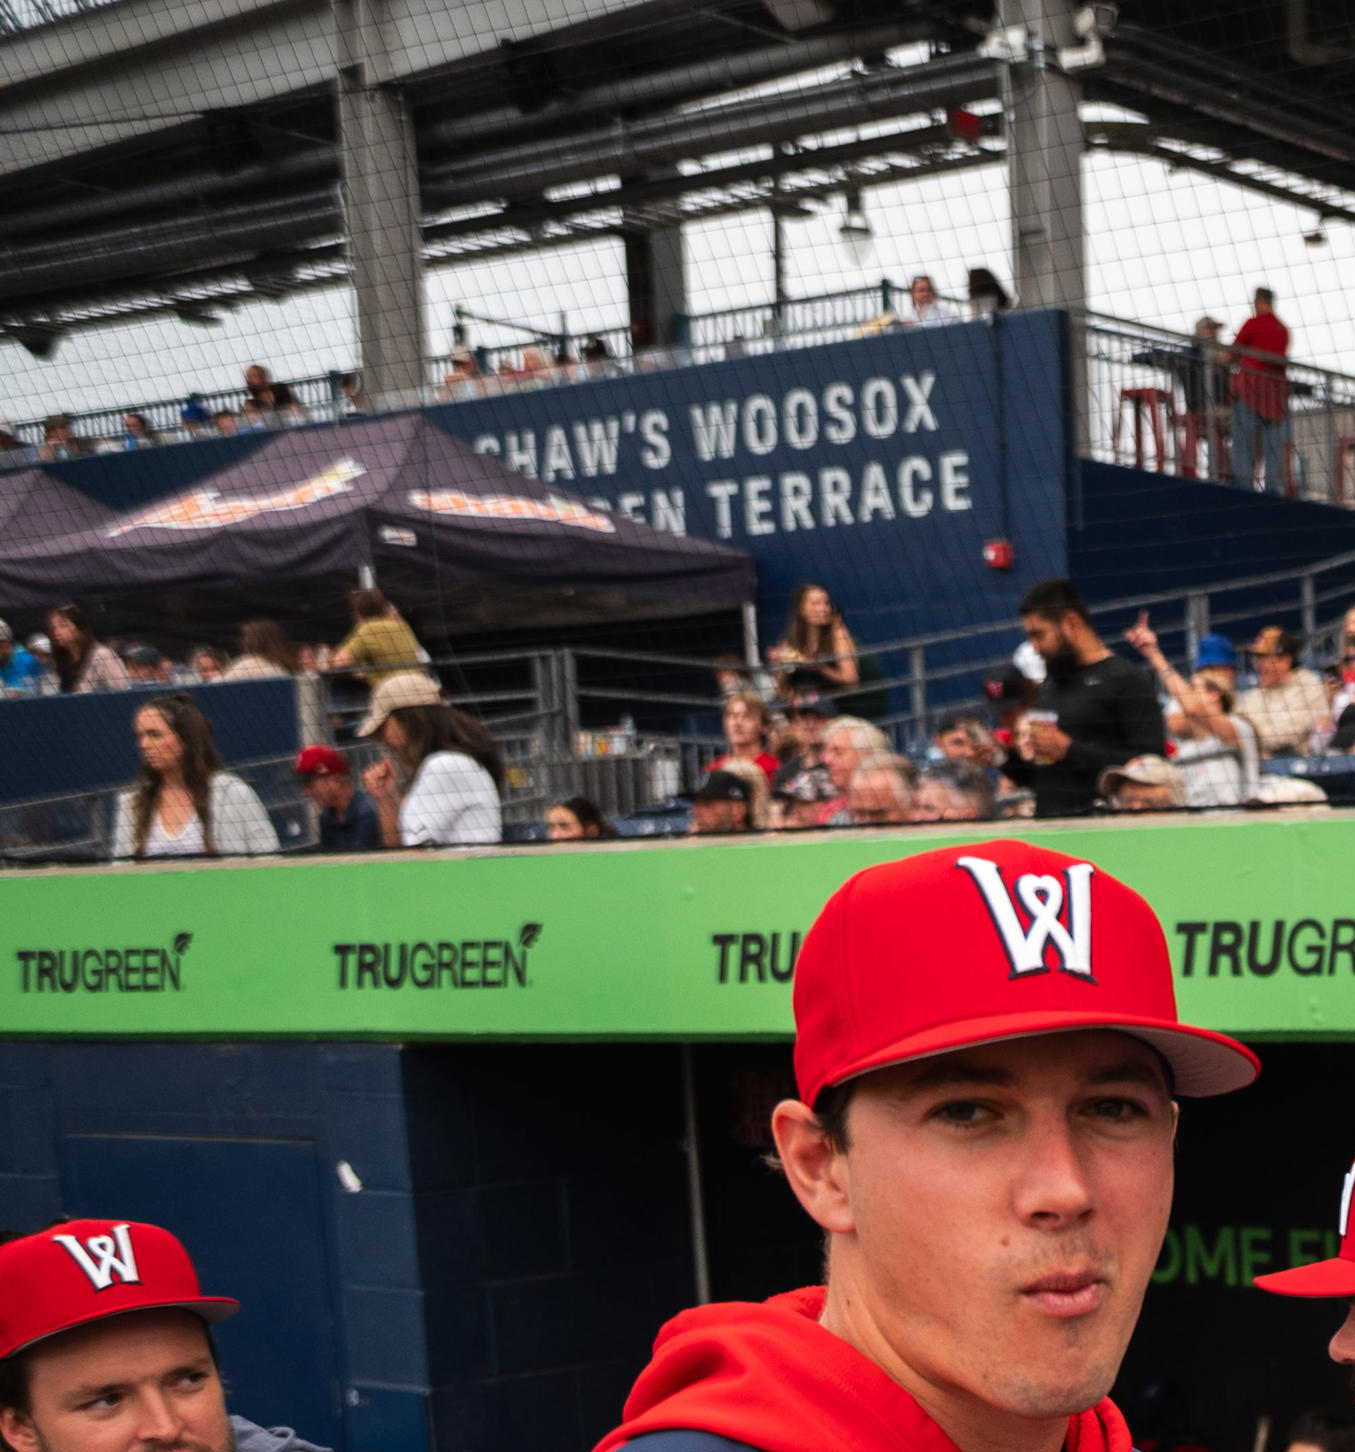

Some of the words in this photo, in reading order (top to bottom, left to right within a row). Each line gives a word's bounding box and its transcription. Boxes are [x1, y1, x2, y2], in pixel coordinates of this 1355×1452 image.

[690, 370, 939, 462] WOOSOX
[706, 449, 973, 539] TERRACE
[956, 856, 1098, 984] W
[17, 946, 184, 993] TRUGREEN
[333, 940, 530, 989] TRUGREEN
[53, 1224, 142, 1292] W
